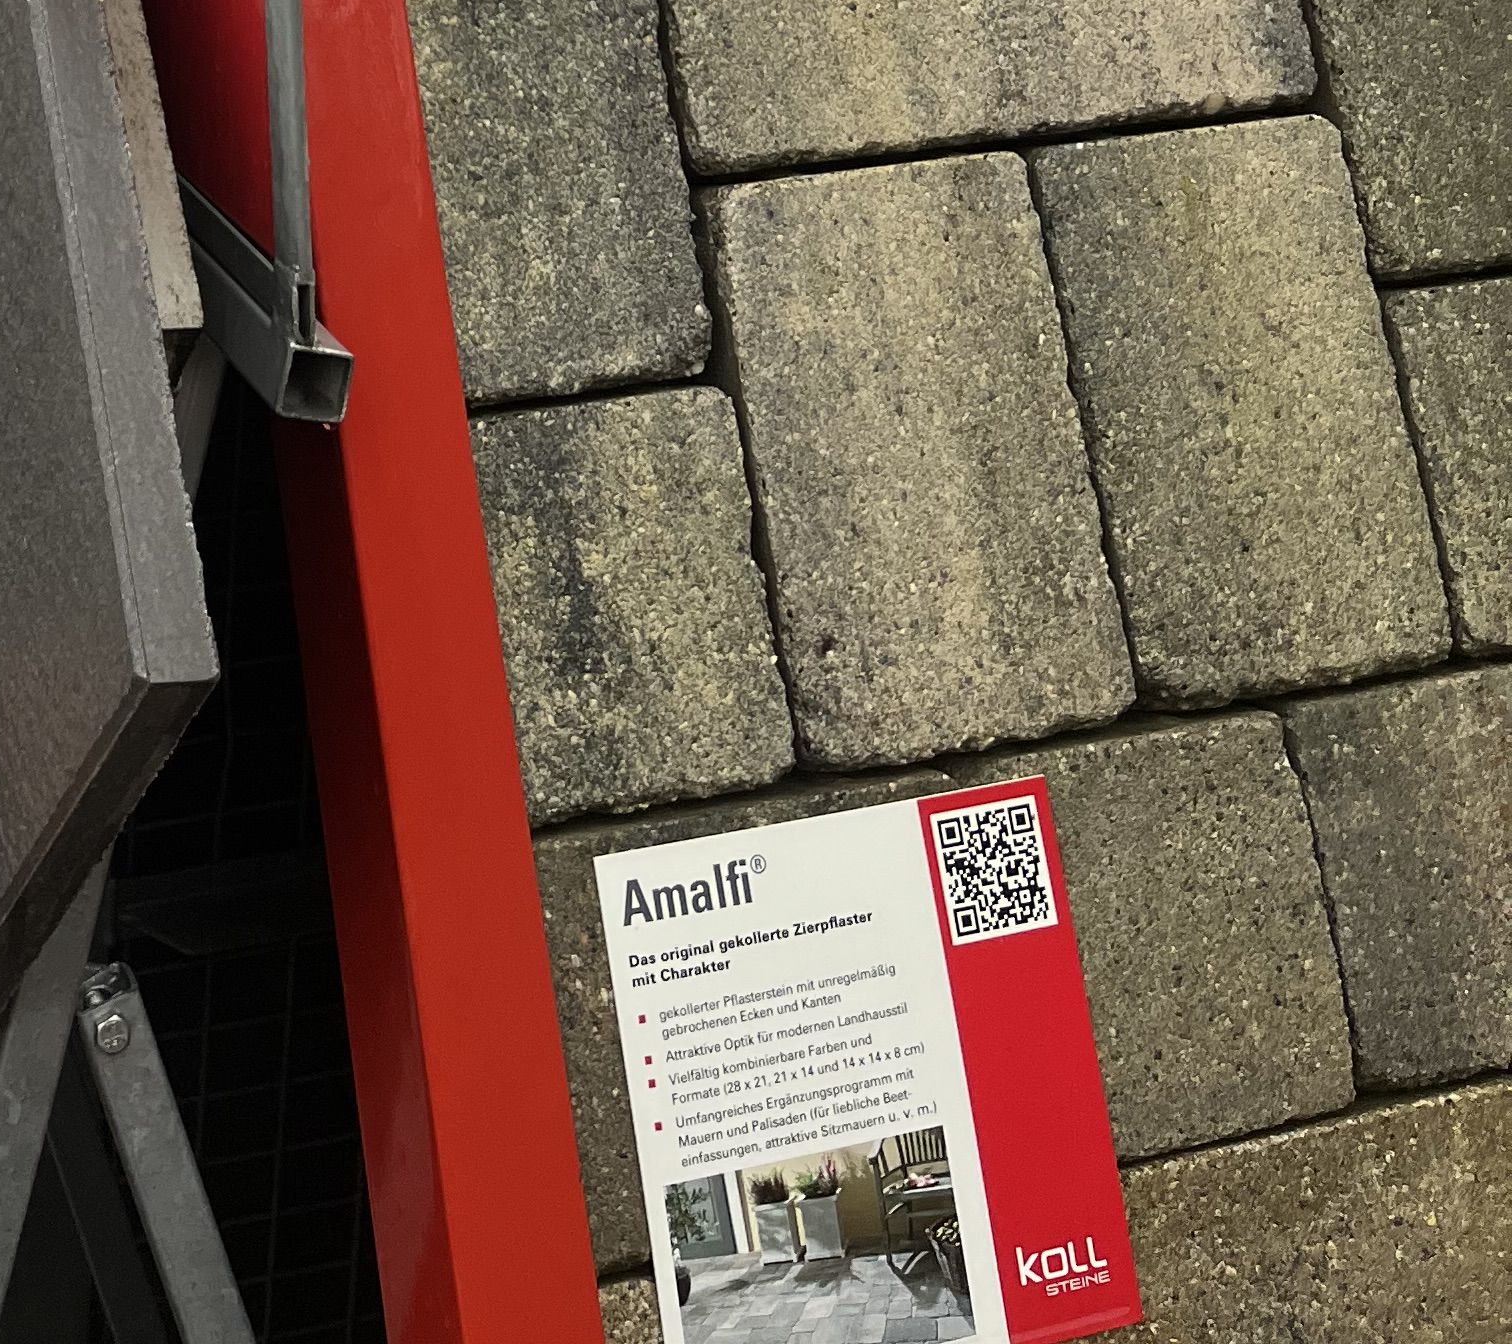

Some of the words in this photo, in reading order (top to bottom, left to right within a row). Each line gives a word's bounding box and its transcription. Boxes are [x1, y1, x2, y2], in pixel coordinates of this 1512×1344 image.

[628, 954, 656, 968] Das
[660, 939, 715, 962] original
[718, 928, 789, 954] gekollerte
[792, 912, 872, 936] Zierpflaster
[631, 971, 657, 988] mit
[659, 959, 731, 982] Charakter
[658, 1000, 720, 1023] gekollerter
[722, 984, 794, 1008] Pflasterstein
[795, 979, 816, 993] mit
[817, 963, 896, 989] unregelmäßig
[661, 1014, 737, 1041] gebrochenen
[739, 1007, 774, 1022] Ecken
[776, 999, 799, 1015] und
[800, 993, 842, 1010] Kanten
[665, 1042, 721, 1063] Attraktive
[723, 1034, 755, 1051] Optik
[756, 1030, 773, 1044] für
[776, 1019, 835, 1040] modernen
[836, 1001, 908, 1027] Landhausstil
[667, 1067, 720, 1086] Vielfältig
[721, 1049, 806, 1075] kombinierbare
[807, 1040, 848, 1057] Farben
[850, 1032, 873, 1048] und
[671, 1087, 721, 1105] Formate
[722, 1079, 742, 1095] (28
[773, 1070, 787, 1084] 21
[800, 1064, 814, 1078] 14
[816, 1059, 839, 1075] und
[841, 1056, 856, 1069] 14
[867, 1050, 882, 1064] 14
[893, 1046, 901, 1059] 8
[903, 1041, 925, 1057] cm)
[674, 1101, 764, 1128] Umfangreiches
[765, 1074, 893, 1110] Ergänzungsprogramm
[894, 1067, 914, 1082] mit
[677, 1130, 723, 1148] Mauern
[725, 1121, 749, 1138] und
[751, 1112, 807, 1132] Palisaden
[809, 1105, 830, 1121] (für
[831, 1095, 880, 1115] liebliche
[882, 1089, 911, 1104] Beet-
[680, 1142, 762, 1167] einfassungen,
[765, 1129, 818, 1150] attraktive
[820, 1115, 885, 1137] Sitzmauern
[1015, 1236, 1108, 1287] KOLL
[1045, 1269, 1111, 1297] STEINE
